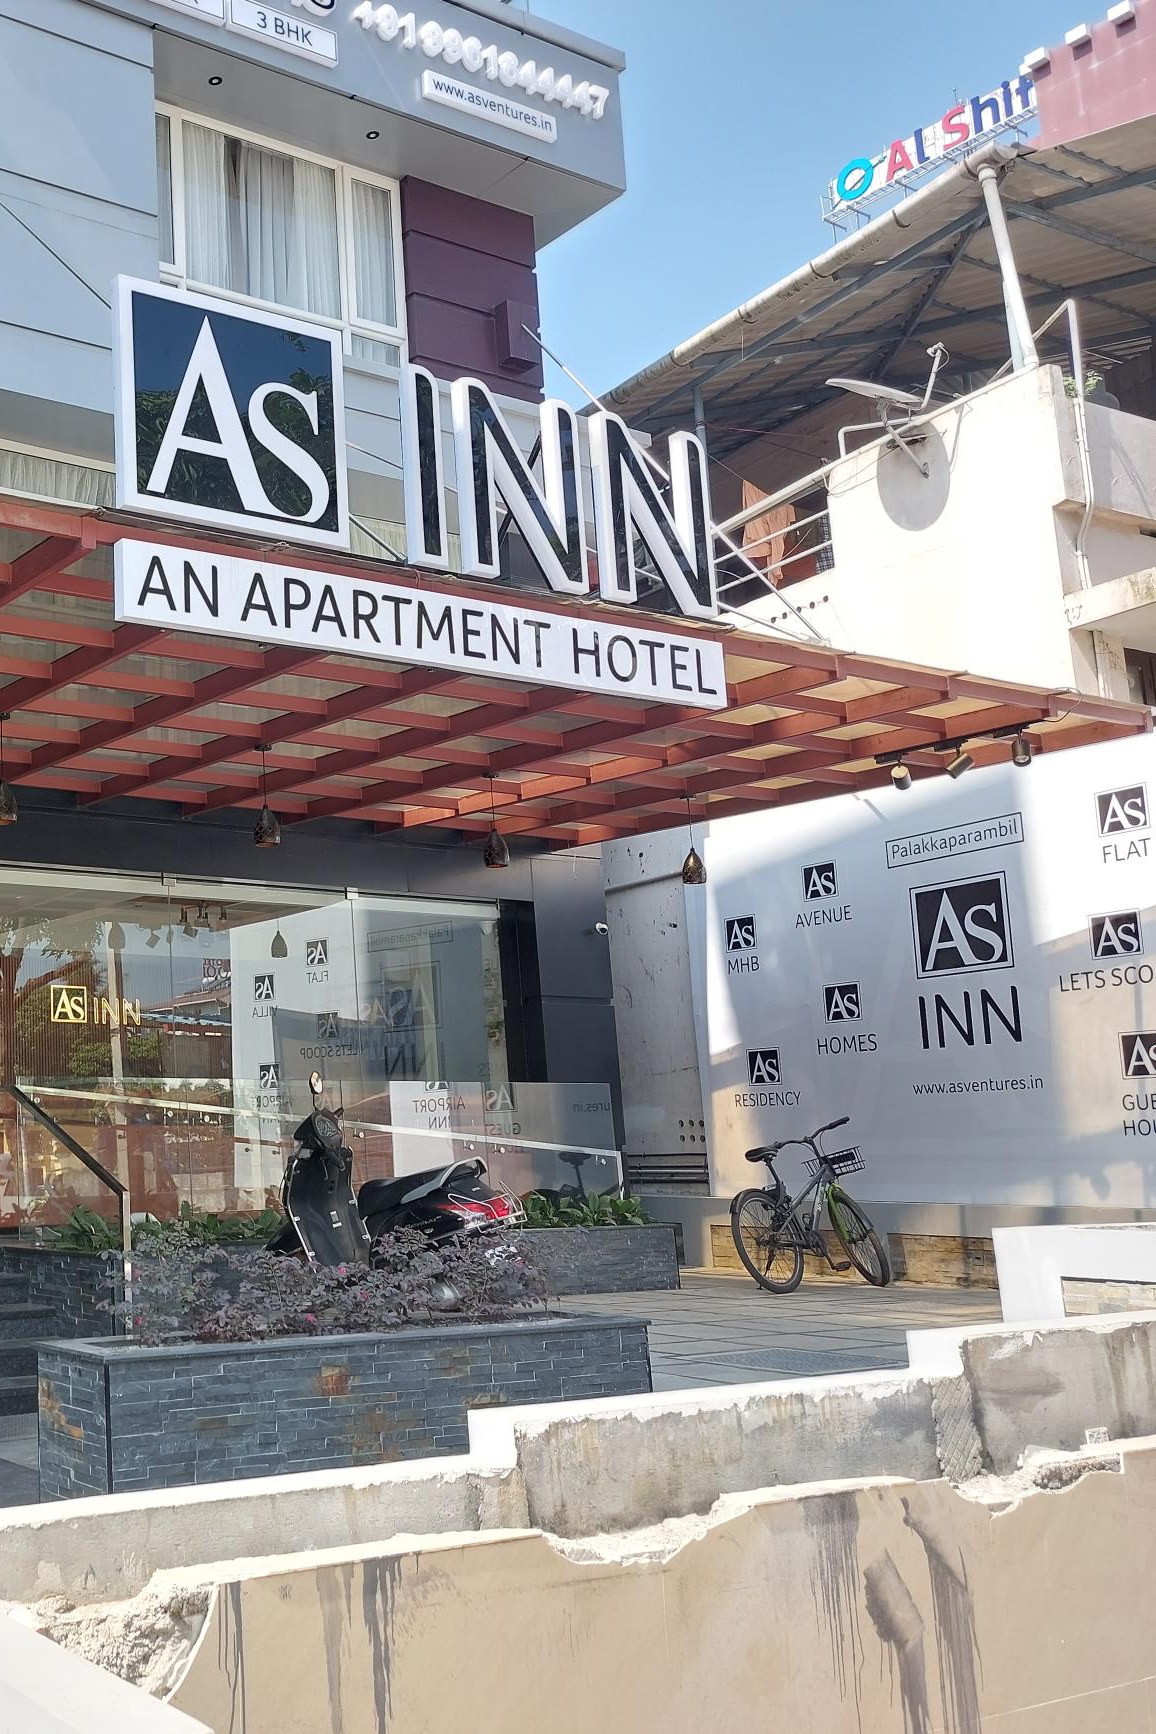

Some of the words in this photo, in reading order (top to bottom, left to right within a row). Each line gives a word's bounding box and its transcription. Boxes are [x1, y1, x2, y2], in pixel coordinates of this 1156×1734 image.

[256, 11, 268, 29] 3
[274, 17, 314, 47] BHK
[432, 76, 553, 132] www.asventures.in
[400, 362, 720, 619] INN
[136, 555, 220, 618] AN
[240, 573, 550, 669] APARTMENT
[571, 626, 719, 696] HOTEL
[891, 818, 1018, 860] Palakkaparambil
[1102, 838, 1151, 864] FLAT
[795, 905, 853, 929] AVENUE
[728, 956, 760, 975] MHB
[1059, 969, 1106, 992] LETS
[94, 998, 141, 1025] INN
[918, 985, 1023, 1050] INN
[817, 1033, 878, 1055] HOMES
[912, 1074, 1044, 1095] www.asventures.in
[734, 1091, 801, 1108] RESIDENCY
